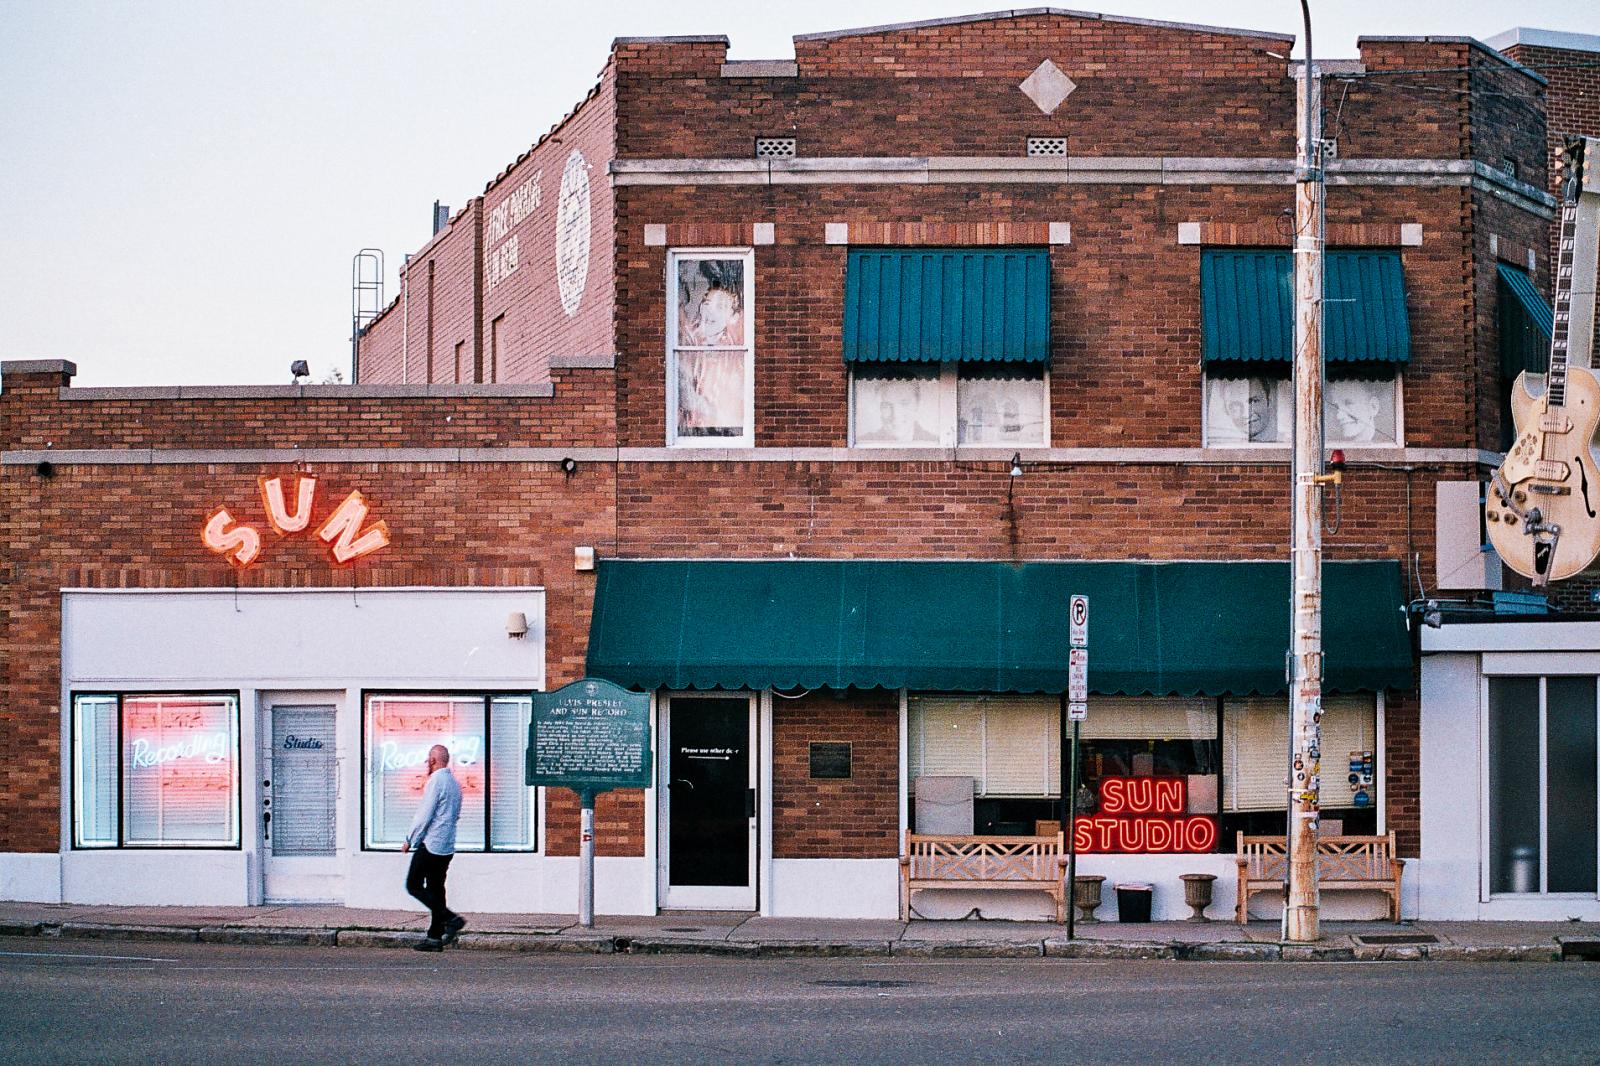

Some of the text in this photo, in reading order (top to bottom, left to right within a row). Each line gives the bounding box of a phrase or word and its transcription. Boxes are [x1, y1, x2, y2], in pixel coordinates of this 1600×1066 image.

[201, 473, 391, 568] SUN
[586, 699, 622, 707] PRESLEY
[131, 732, 227, 769] Recording
[284, 734, 323, 749] Studio
[1103, 779, 1182, 812] SUN
[1074, 817, 1215, 851] STUDIO
